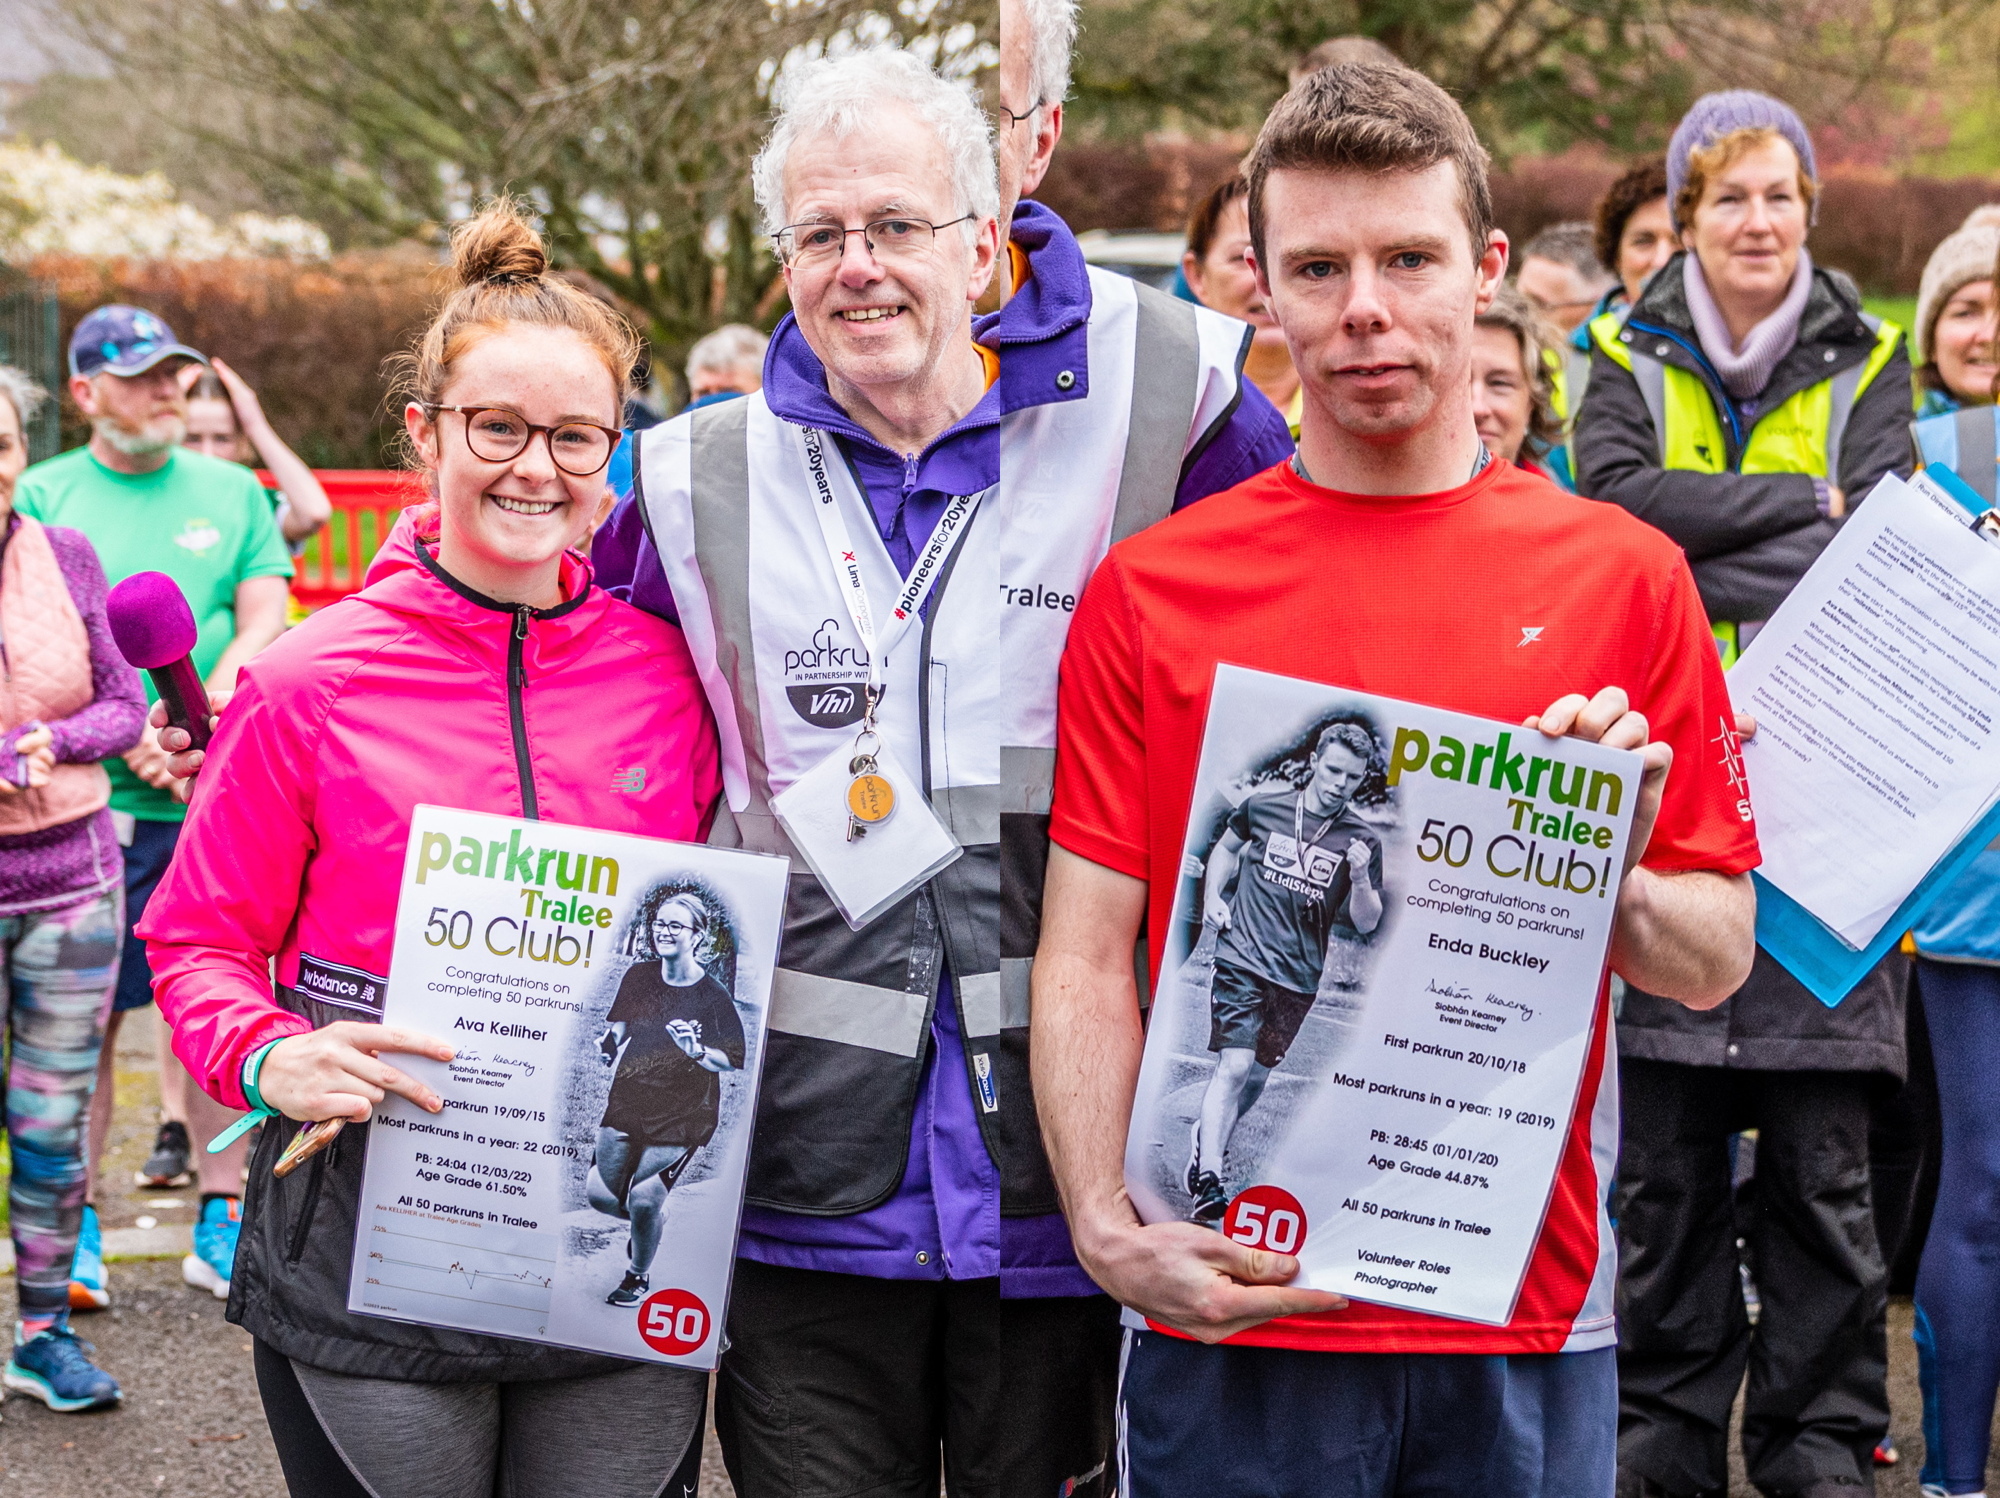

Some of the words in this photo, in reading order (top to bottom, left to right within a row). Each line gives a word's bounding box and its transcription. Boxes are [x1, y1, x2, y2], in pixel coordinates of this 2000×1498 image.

[1917, 482, 1931, 497] Run
[1929, 493, 1955, 516] Director
[894, 495, 972, 621] #pioneersfor20ye
[1871, 540, 1888, 554] team
[1886, 551, 1901, 564] next
[1908, 556, 1924, 570] Book
[1923, 556, 1953, 580] volunteers
[1820, 606, 1842, 626] Buckley
[804, 671, 853, 681] PARTNERSHIP
[854, 671, 869, 679] WIT
[1819, 663, 1836, 678] Adam
[1835, 674, 1851, 689] Moss
[1826, 599, 1838, 611] Ava
[1837, 607, 1859, 625] Kelliher
[1976, 709, 1992, 724] Enda
[1839, 643, 1851, 654] Pat
[1849, 650, 1872, 670] Hewson
[1877, 671, 1892, 685] John
[1891, 680, 1915, 701] Mitchell
[810, 693, 851, 715] Vhi
[1966, 713, 1976, 723] 50
[1387, 726, 1624, 817] parkrun
[1507, 798, 1614, 850] Tralee
[415, 828, 620, 897] parkrun
[1416, 818, 1474, 868] 50
[1486, 834, 1612, 899] Club!
[1263, 869, 1324, 900] #LidlSteps
[1428, 879, 1546, 914] Congratulations
[1550, 906, 1570, 919] on
[520, 888, 613, 930] Tralee
[1406, 895, 1492, 924] completing
[1496, 910, 1514, 925] 50
[1517, 918, 1585, 940] parkruns!
[424, 906, 474, 950] 50
[484, 915, 595, 969] Club!
[1428, 933, 1473, 955] Enda
[1479, 943, 1550, 973] Buckley
[445, 965, 549, 991] Congratulations
[553, 984, 570, 994] on
[427, 982, 502, 1003] completing
[506, 991, 522, 1004] 50
[525, 996, 585, 1013] parkruns!
[1435, 1002, 1469, 1015] Siobhán
[1471, 1010, 1507, 1024] Kearney
[454, 1016, 484, 1032] Ava
[490, 1021, 547, 1041] Kelliher
[1439, 1014, 1462, 1025] Event
[1464, 1019, 1498, 1032] Director
[448, 1061, 479, 1074] Siobhán
[481, 1069, 512, 1080] Kearney
[1384, 1034, 1409, 1049] First
[1412, 1042, 1464, 1061] parkrun
[1468, 1051, 1526, 1074] 20/10/18
[453, 1074, 473, 1083] Event
[475, 1077, 505, 1088] Director
[442, 1099, 488, 1114] parkrun
[495, 1105, 545, 1122] 19/09/15
[1333, 1072, 1365, 1089] Most
[1368, 1082, 1426, 1102] parkruns
[1429, 1093, 1441, 1105] in
[1446, 1099, 1455, 1108] a
[1459, 1101, 1492, 1116] year:
[1498, 1107, 1512, 1120] 19
[1516, 1112, 1555, 1130] (2019)
[377, 1114, 406, 1128] Most
[409, 1122, 459, 1139] parkruns
[463, 1131, 474, 1142] in
[477, 1136, 486, 1144] a
[490, 1138, 519, 1150] year:
[523, 1141, 538, 1152] 22
[542, 1144, 579, 1161] (2019)
[1370, 1129, 1390, 1144] PB:
[1394, 1134, 1428, 1151] 28:45
[1432, 1143, 1499, 1167] (01/01/20)
[415, 1152, 432, 1164] PB:
[436, 1156, 466, 1171] 24:04
[471, 1164, 532, 1183] (12/03/22)
[416, 1168, 440, 1182] Age
[444, 1173, 482, 1189] Grade
[485, 1181, 527, 1197] 61.50%
[1368, 1154, 1395, 1170] Age
[1400, 1161, 1441, 1179] Grade
[1445, 1171, 1489, 1189] 44.87%
[398, 1195, 413, 1206] All
[416, 1198, 430, 1209] 50
[433, 1203, 484, 1220] parkruns
[488, 1212, 498, 1222] in
[502, 1214, 538, 1229] Tralee
[1231, 1201, 1300, 1254] 50
[1341, 1198, 1359, 1211] All
[1362, 1201, 1378, 1215] 50
[1380, 1208, 1436, 1226] parkruns
[1438, 1217, 1450, 1229] in
[1454, 1219, 1491, 1236] Tralee
[1358, 1249, 1415, 1268] Volunteer
[1418, 1260, 1451, 1275] Roles
[1354, 1271, 1438, 1294] Photographer
[645, 1301, 704, 1344] 50
